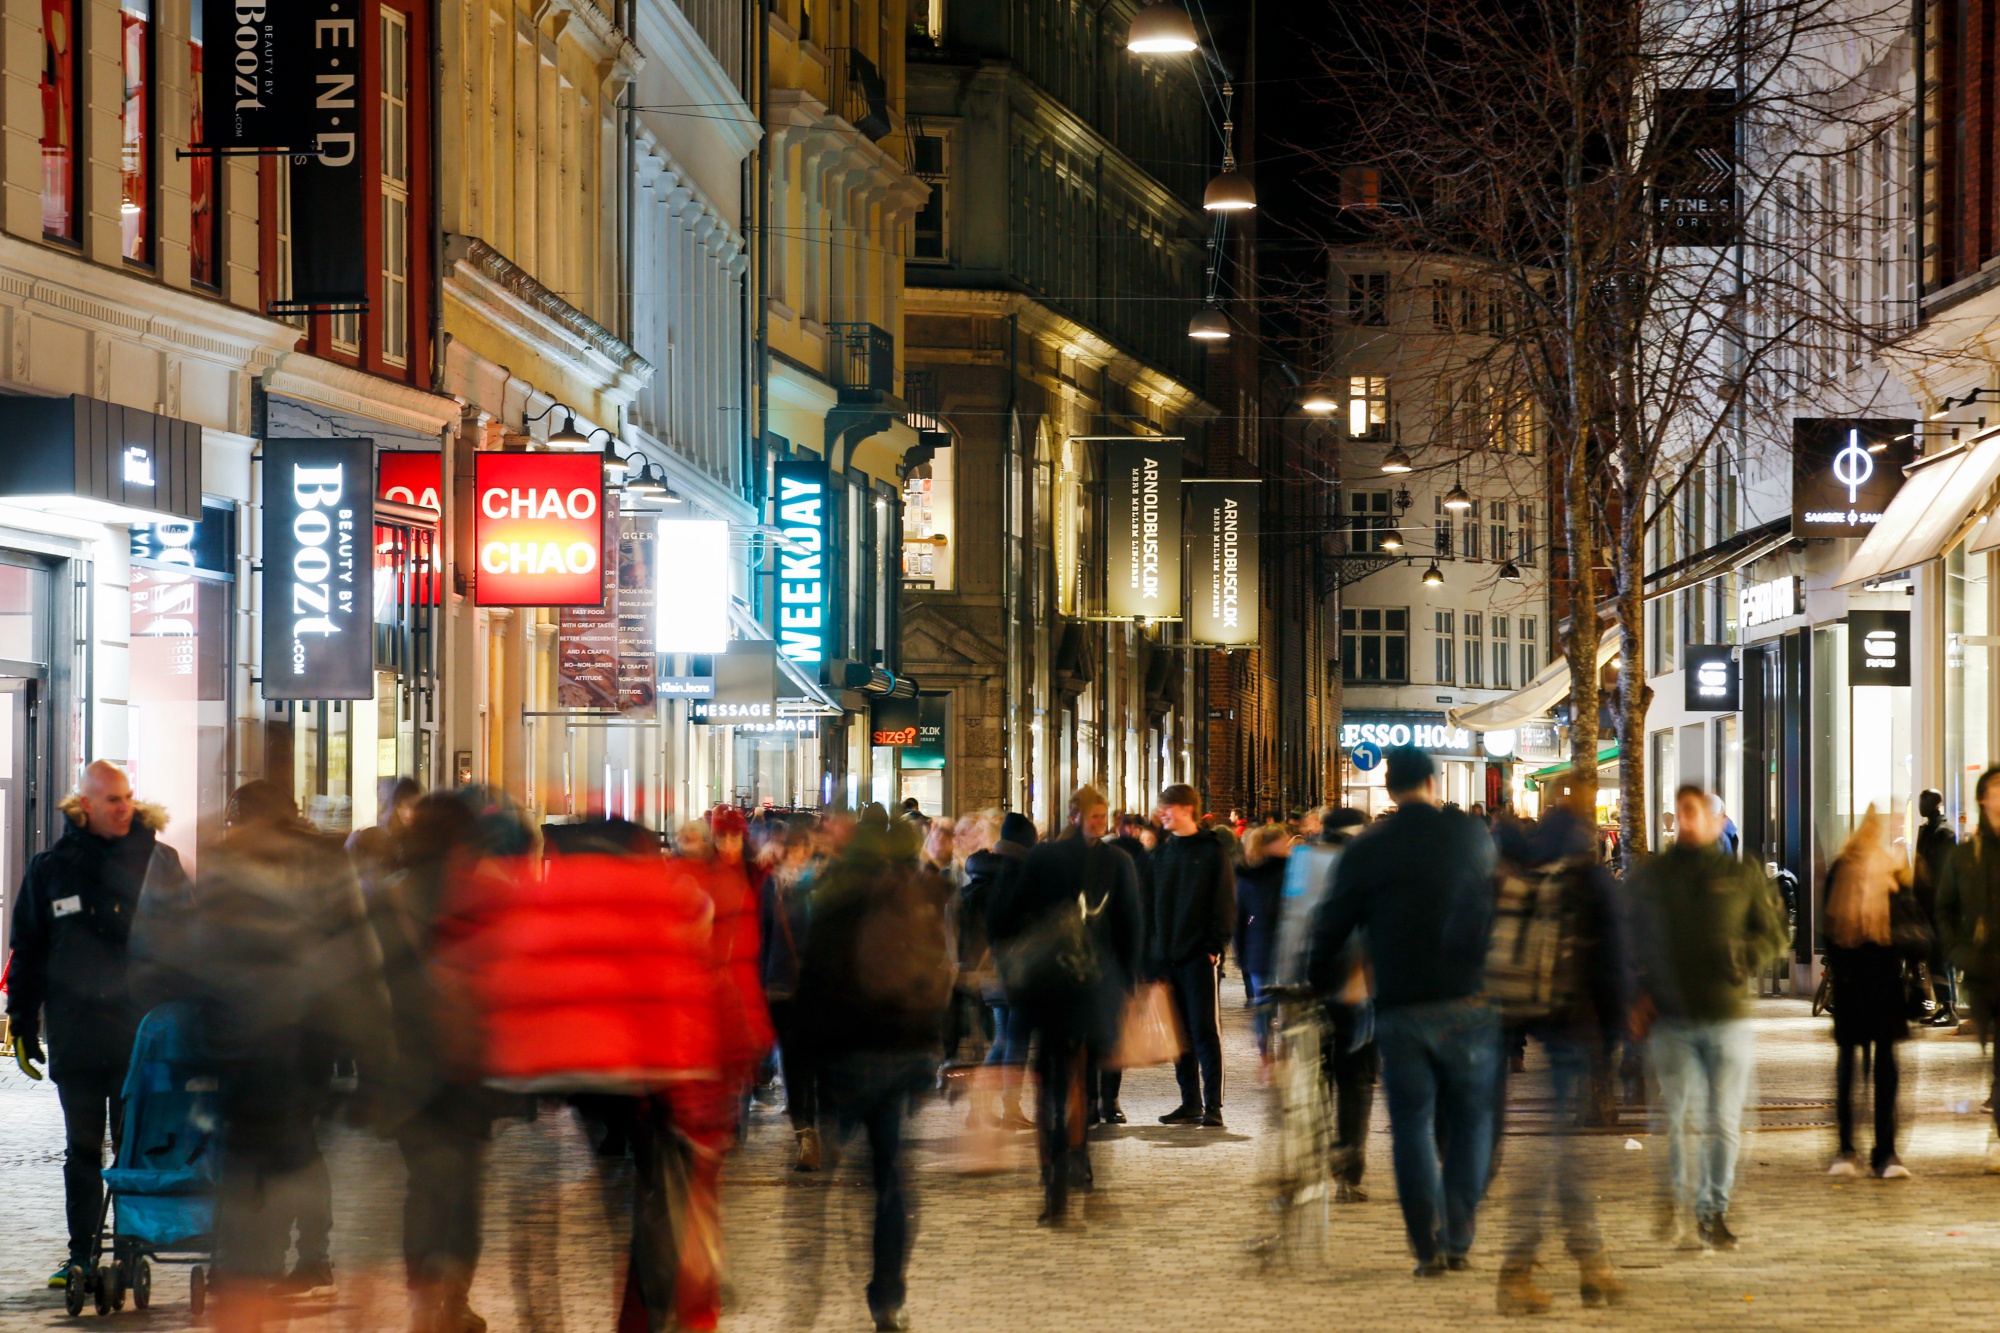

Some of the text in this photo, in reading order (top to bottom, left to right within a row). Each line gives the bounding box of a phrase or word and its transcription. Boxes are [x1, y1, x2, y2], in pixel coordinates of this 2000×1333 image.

[264, 25, 273, 95] BEAUTY BY
[1660, 199, 1729, 212] FTNES
[1661, 218, 1729, 227] ORLD
[481, 487, 597, 520] CHAO
[619, 532, 654, 540] GGER
[1143, 457, 1158, 599] ARNOLDBUSCK.DK
[338, 509, 352, 613] BEAUTY BY
[481, 541, 597, 575] CHAO
[781, 477, 821, 662] WEEKDAY
[1223, 498, 1238, 628] ARNOLDBUSCK.DK
[662, 682, 684, 693] Klein
[683, 682, 710, 693] Jeans
[695, 703, 771, 717] MESSAGE
[873, 727, 917, 744] size?
[1340, 724, 1411, 748] ESSO
